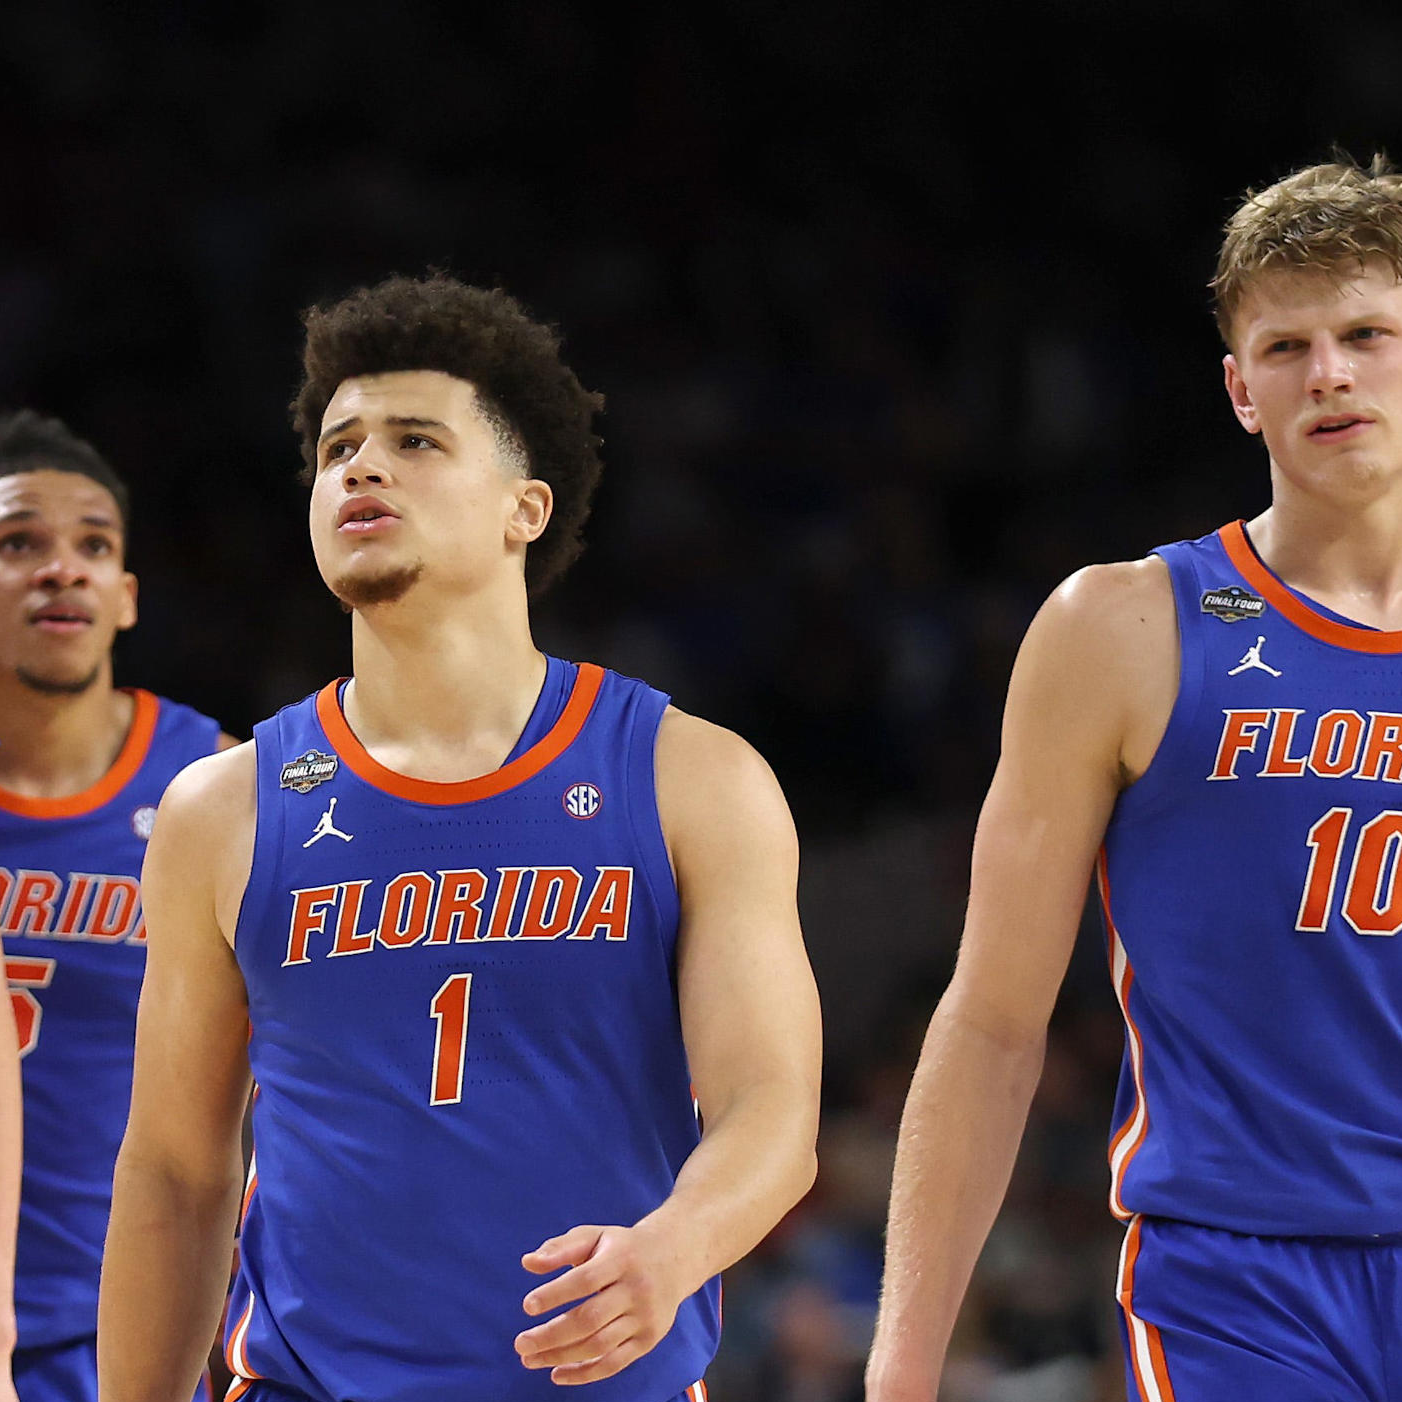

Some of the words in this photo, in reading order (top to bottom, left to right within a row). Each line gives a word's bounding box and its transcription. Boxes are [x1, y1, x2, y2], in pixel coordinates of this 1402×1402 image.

[1204, 595, 1233, 607] FINAL
[1233, 599, 1263, 611] FOUR
[283, 766, 309, 780] FINAL
[309, 762, 335, 775] FOUR
[566, 785, 599, 816] SEC
[280, 866, 634, 967] FLORIDA
[429, 972, 473, 1107] 1
